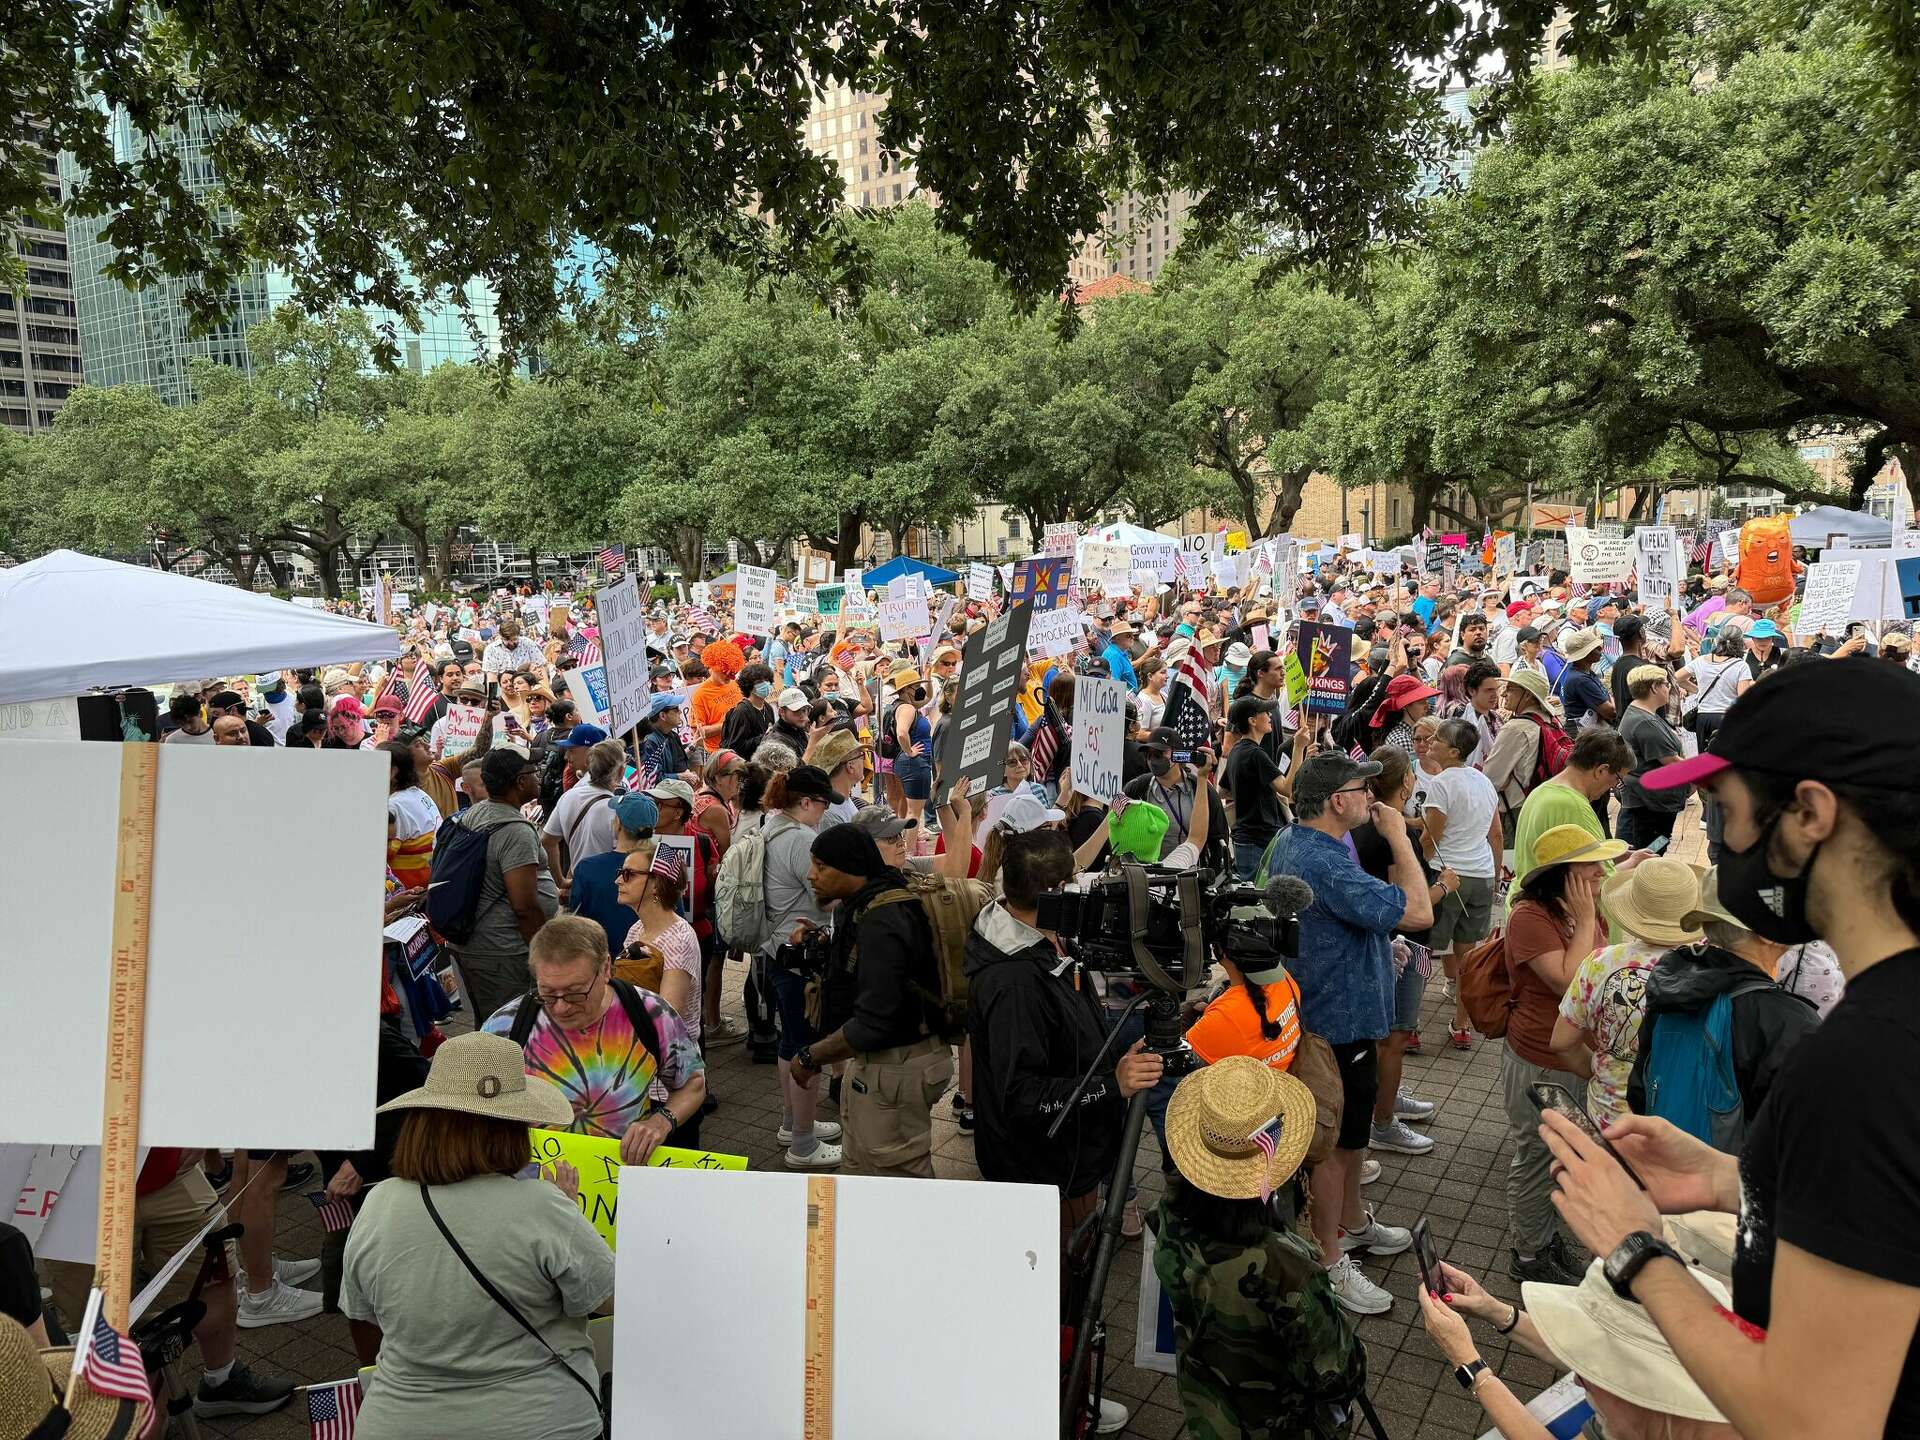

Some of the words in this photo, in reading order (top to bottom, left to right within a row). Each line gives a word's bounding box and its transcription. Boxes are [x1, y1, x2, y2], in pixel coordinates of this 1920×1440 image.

[1130, 545, 1155, 556] Grow
[1160, 545, 1171, 557] up
[1183, 535, 1205, 552] NO
[1132, 558, 1168, 570] Donnie
[747, 576, 765, 588] FORCES
[1644, 580, 1672, 596] TRAITOR
[742, 599, 764, 610] POLITICAL
[1034, 593, 1048, 608] NO
[1028, 622, 1078, 646] DEMOCRACY
[1315, 678, 1345, 690] KINGS
[1080, 680, 1092, 713] Mi
[1094, 680, 1118, 714] Casa
[1316, 690, 1346, 700] PROTEST
[1326, 700, 1346, 709] 2025
[448, 708, 464, 725] My
[447, 724, 477, 736] Should
[1076, 752, 1089, 786] Su
[1092, 760, 1119, 800] Casa
[116, 947, 130, 978] THE
[113, 982, 128, 1028] HOME
[110, 1031, 125, 1083] DEPOT
[106, 1116, 119, 1154] HOME
[106, 1157, 117, 1176] OF
[104, 1178, 114, 1204] THE
[102, 1204, 114, 1252] FINEST
[805, 1356, 815, 1384] THE
[804, 1388, 815, 1427] HOME
